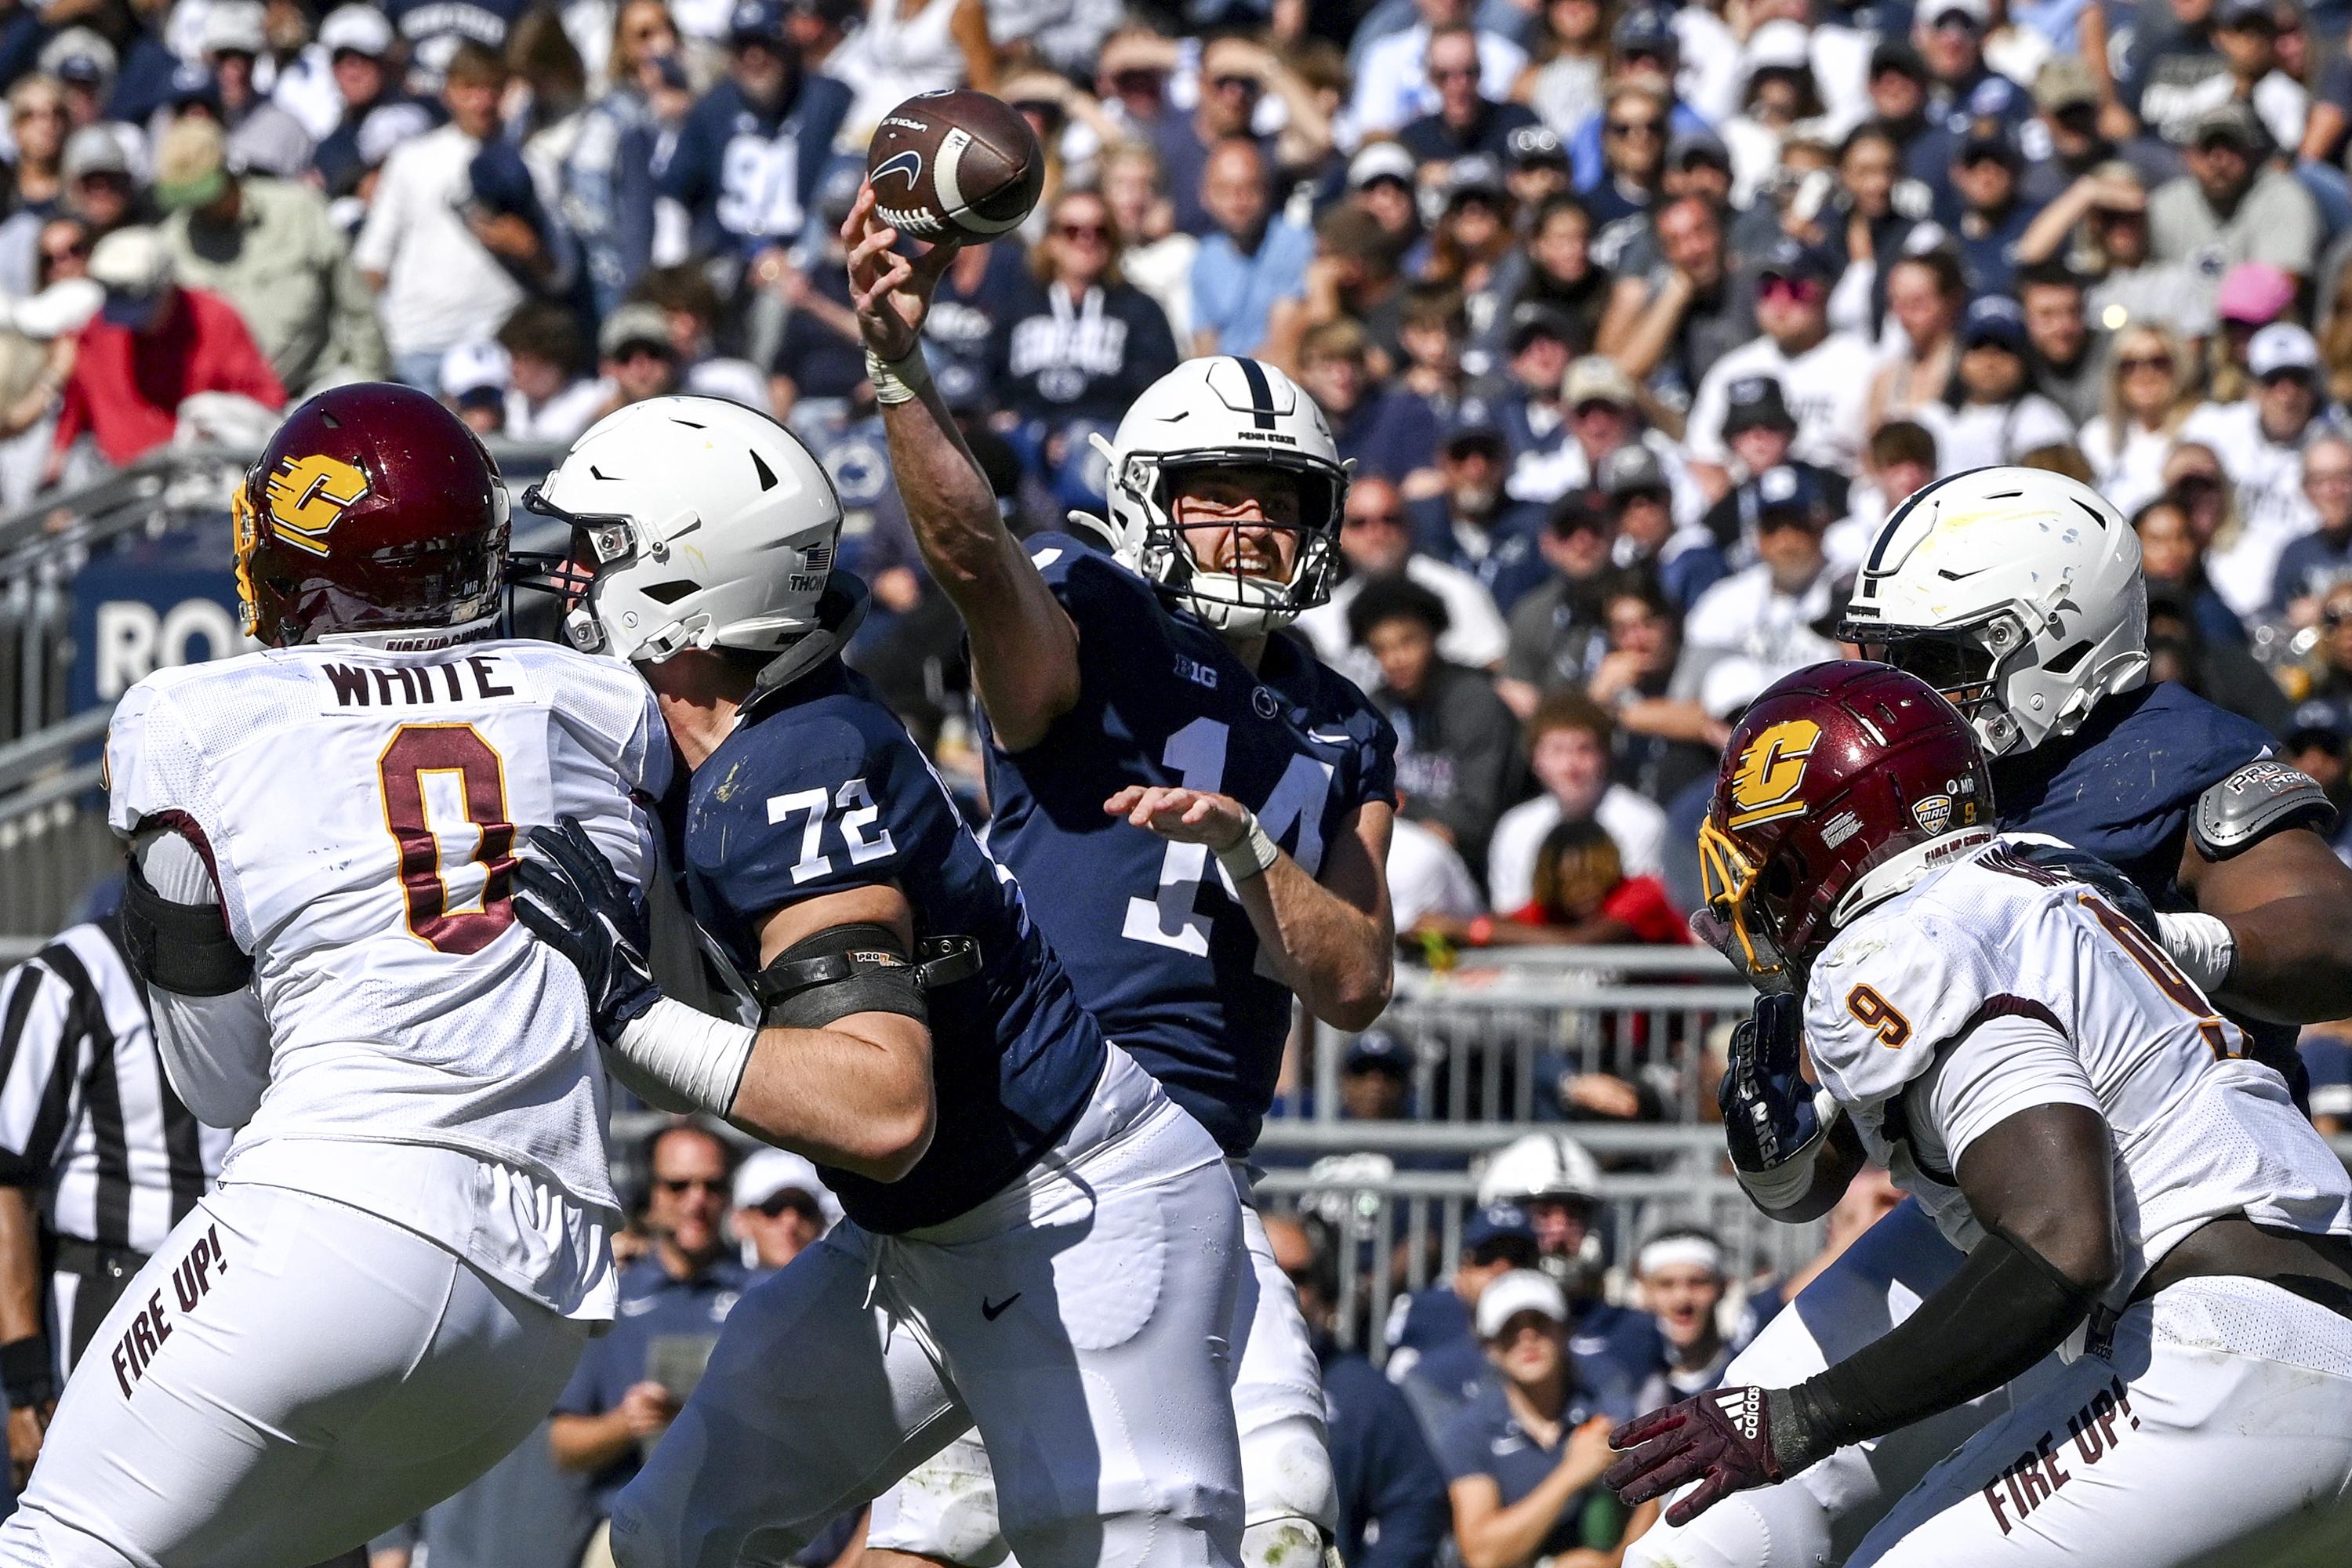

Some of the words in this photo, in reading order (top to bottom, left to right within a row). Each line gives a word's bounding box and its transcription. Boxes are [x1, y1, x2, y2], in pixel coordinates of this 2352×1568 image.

[320, 655, 514, 706] WHITE
[377, 721, 517, 955] 0
[766, 777, 897, 885] 72
[1122, 716, 1334, 987] 14
[1918, 806, 1948, 822] MAC
[1845, 982, 1913, 1049] 9
[111, 1287, 172, 1401] FIRE
[172, 1223, 227, 1312] UP!
[1744, 1386, 1760, 1439] adidas
[1983, 1430, 2071, 1537] FIRE
[2067, 1374, 2140, 1465] UP!
